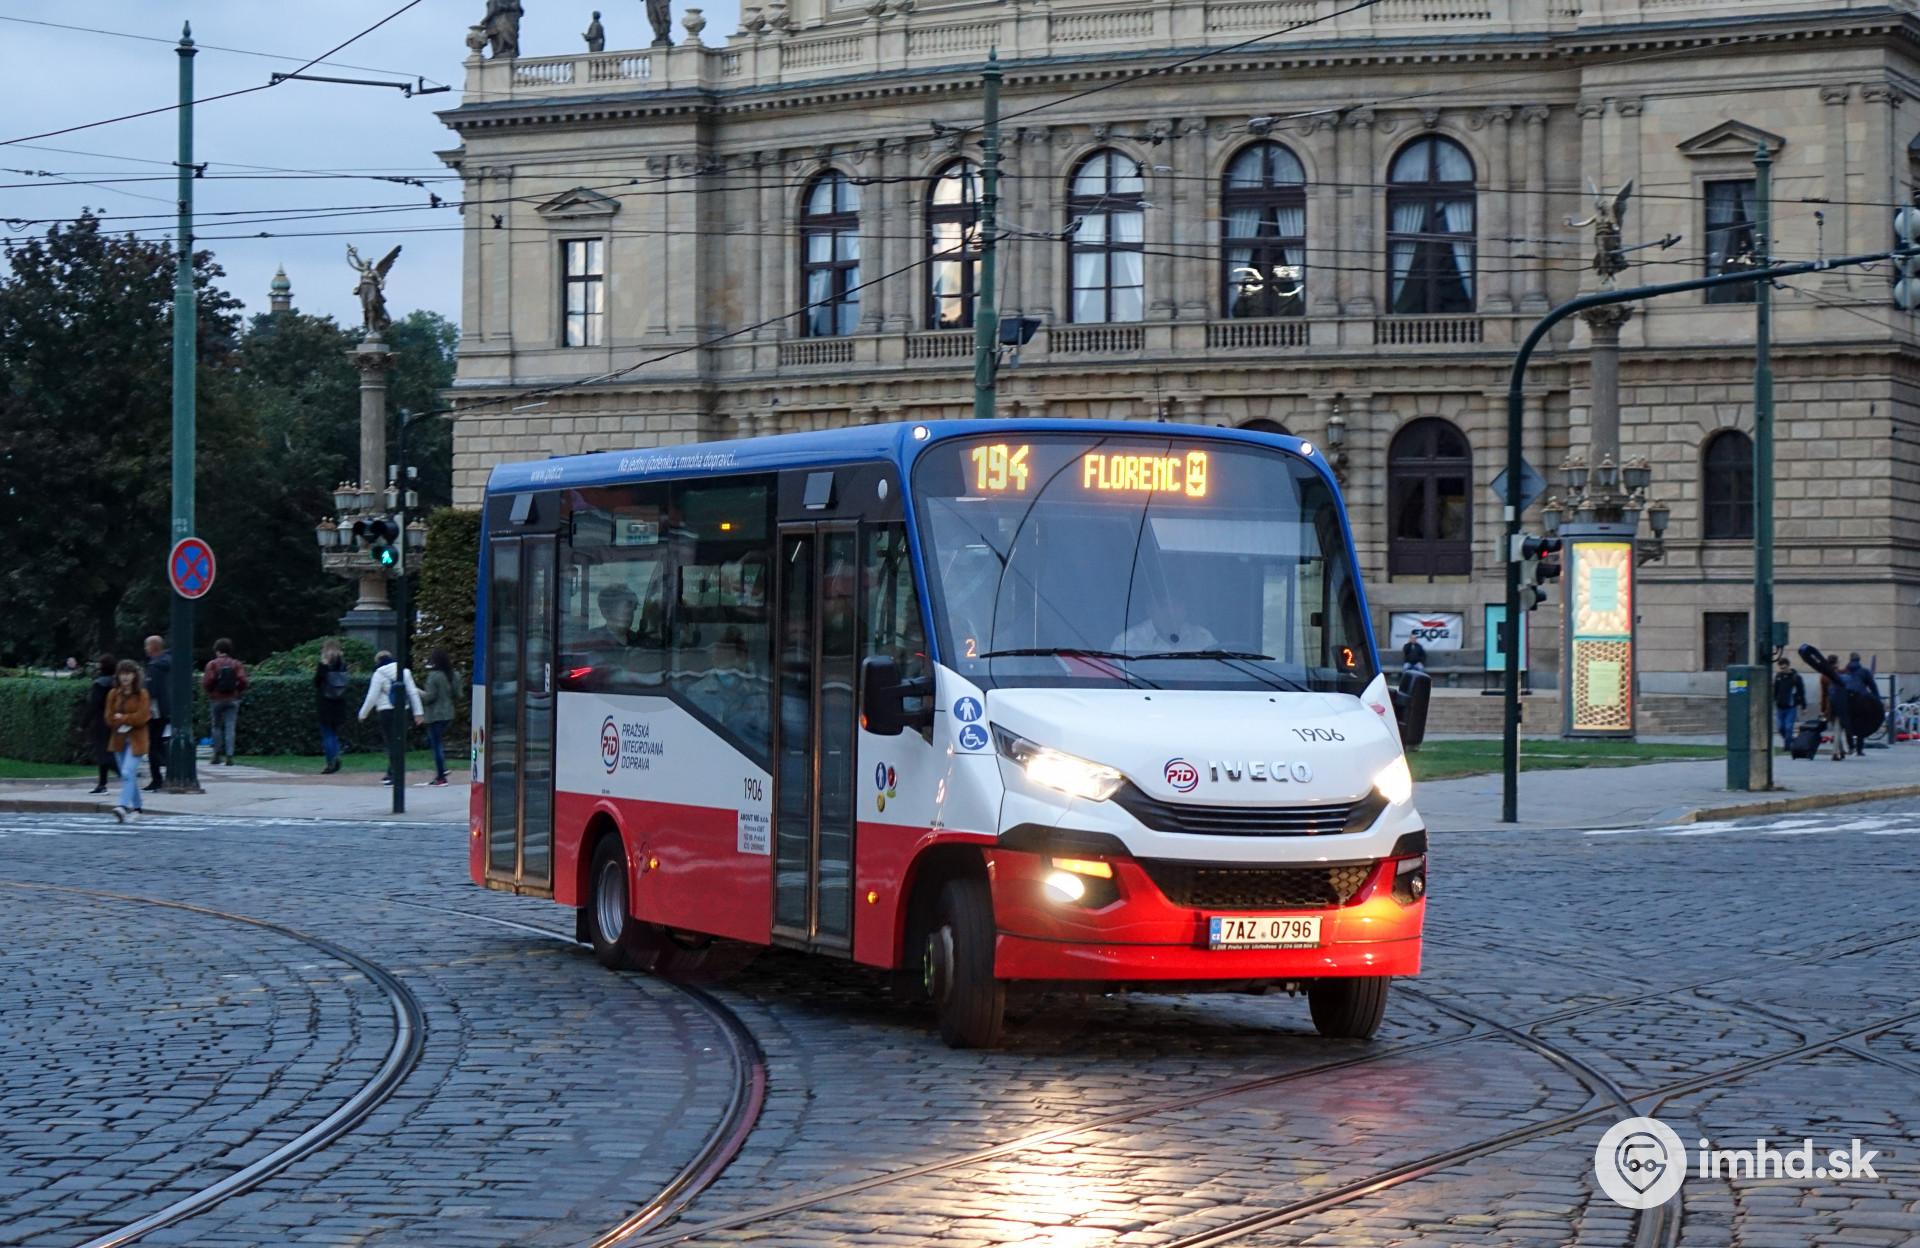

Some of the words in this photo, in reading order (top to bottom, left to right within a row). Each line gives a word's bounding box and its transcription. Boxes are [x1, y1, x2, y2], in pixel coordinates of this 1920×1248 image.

[972, 444, 1029, 491] 194
[1084, 454, 1181, 491] FLORENC
[965, 638, 977, 657] 2
[1343, 648, 1355, 667] 2
[621, 722, 650, 738] PRAŽSKÁ
[1292, 728, 1345, 742] 1906
[621, 740, 664, 757] INTEGROVANÁ
[621, 756, 650, 771] DOPRAVA
[1208, 760, 1313, 783] IVECO
[744, 777, 763, 802] 1906
[1225, 921, 1257, 939] 7AZ
[1270, 921, 1312, 938] 0796
